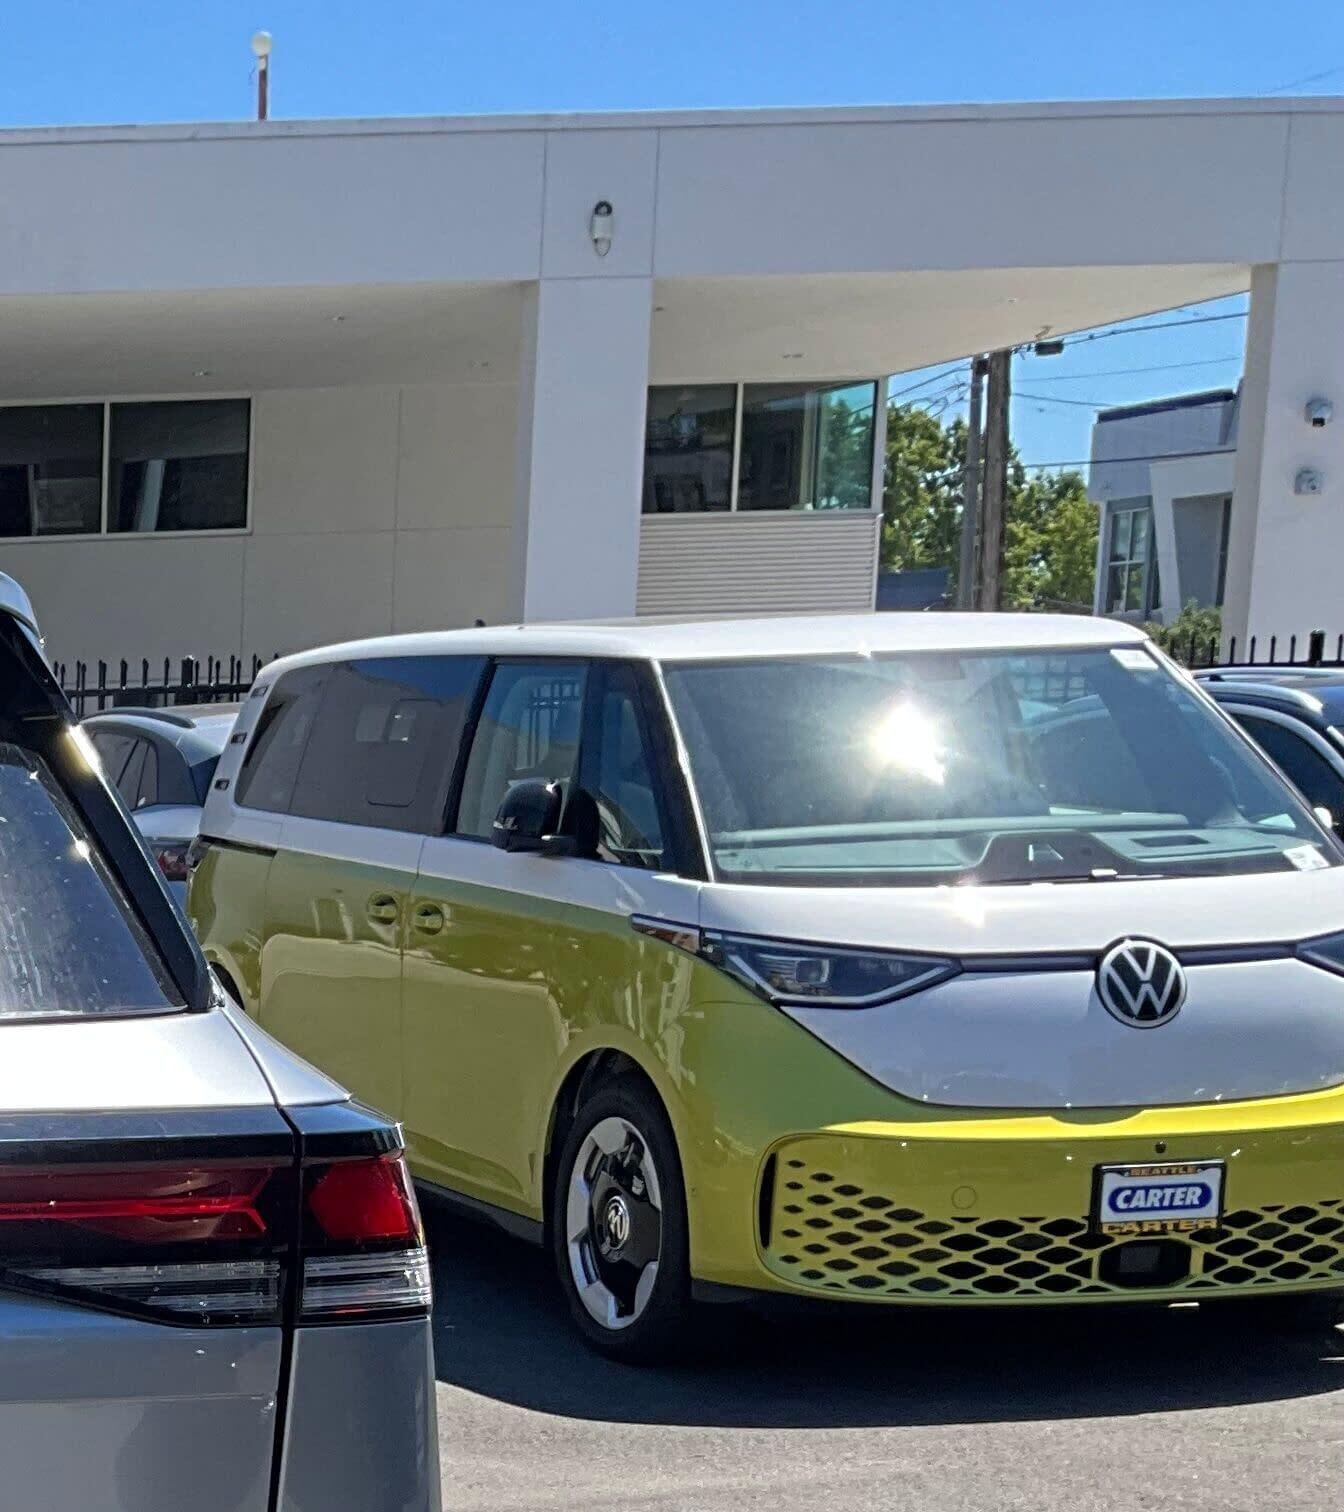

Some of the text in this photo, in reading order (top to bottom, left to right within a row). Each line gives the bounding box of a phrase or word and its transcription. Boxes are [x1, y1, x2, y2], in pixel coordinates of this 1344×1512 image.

[1130, 1166, 1197, 1176] SEATTLE
[1116, 1186, 1202, 1209] CARTER
[1102, 1219, 1217, 1233] CARTER
